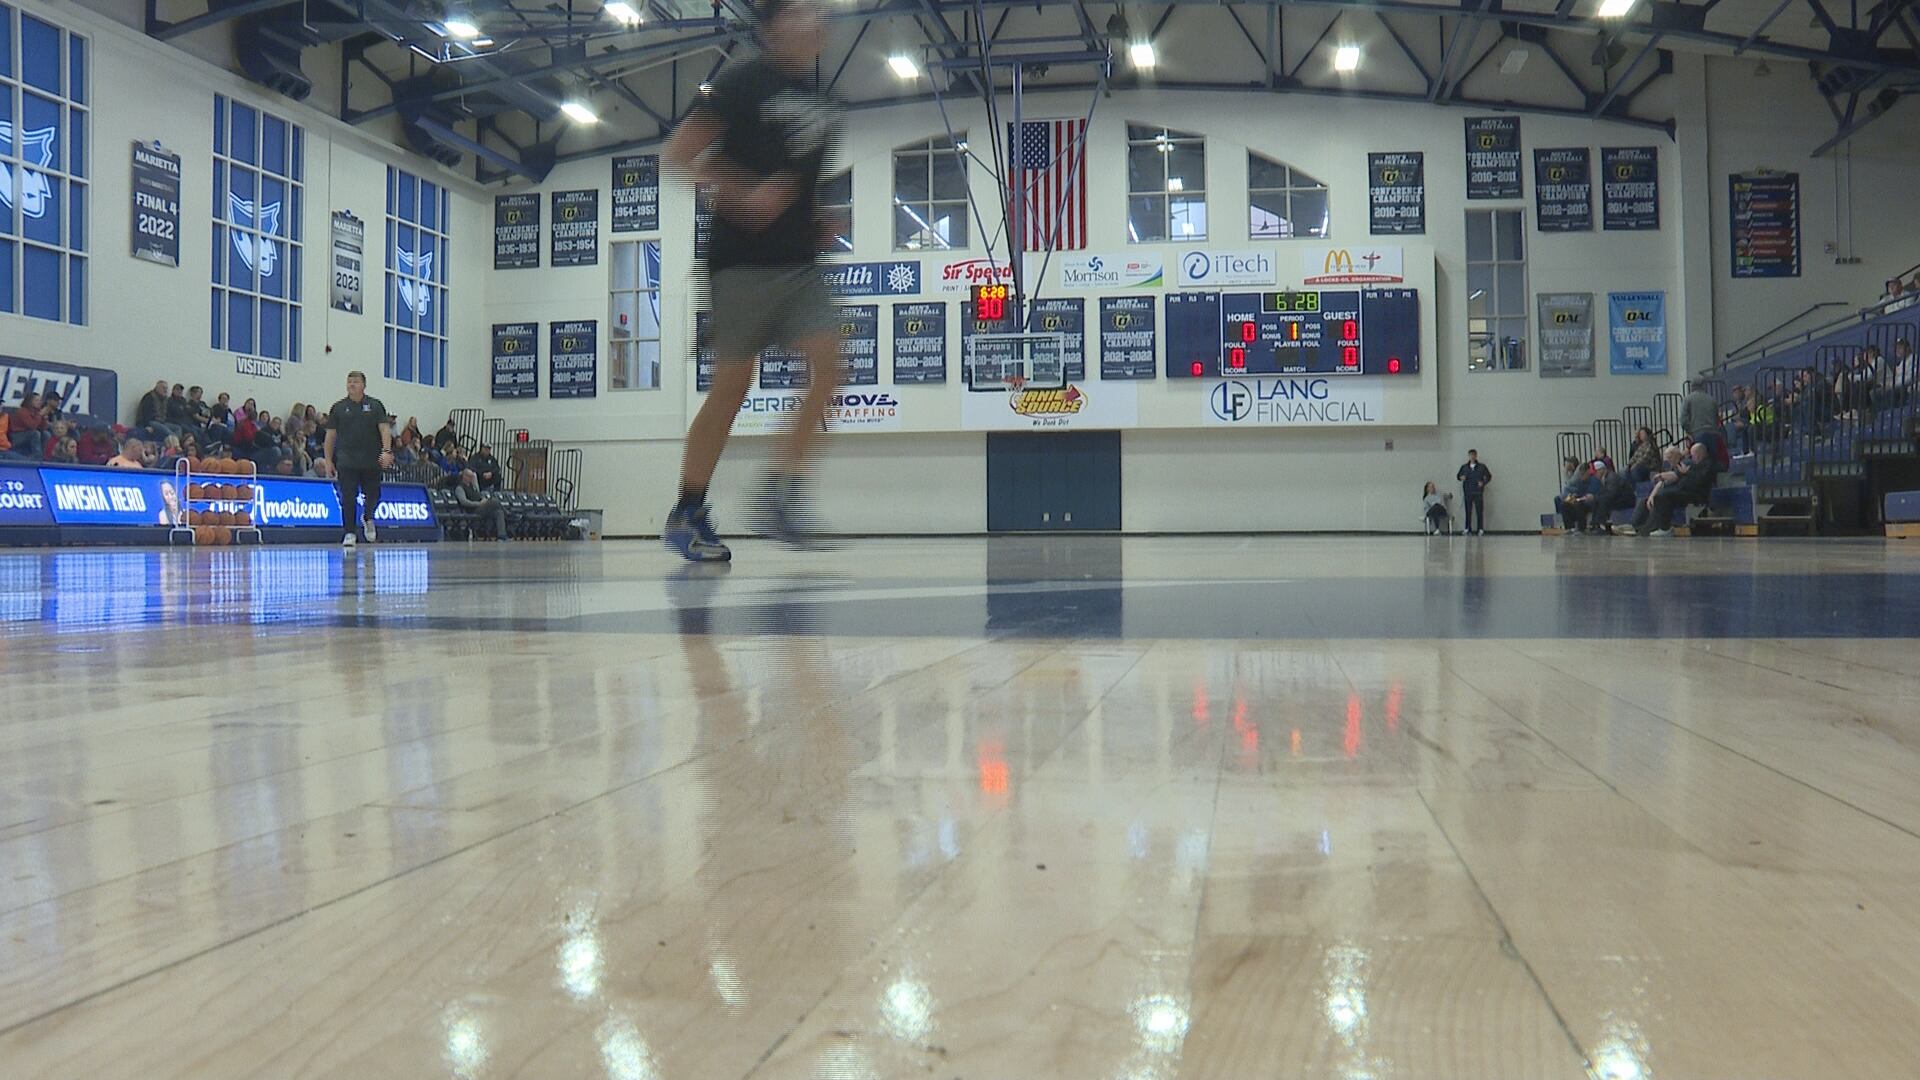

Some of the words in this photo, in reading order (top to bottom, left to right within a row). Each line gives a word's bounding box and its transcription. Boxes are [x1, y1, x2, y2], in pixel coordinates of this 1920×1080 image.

[1467, 151, 1520, 161] TOURNAMENT
[135, 150, 179, 174] MARIETTA
[1471, 159, 1517, 168] CHAMPIONS
[1471, 171, 1517, 183] 2010-2011
[613, 186, 658, 197] CONFERENCE
[1370, 186, 1423, 195] CONFERENCE
[136, 192, 168, 214] FINAL
[169, 201, 177, 216] 4
[615, 194, 657, 204] CHAMPIONS
[1373, 194, 1421, 203] CHAMPIONS
[1374, 206, 1420, 218] 2010-2011
[138, 213, 175, 240] 2022
[496, 224, 539, 235] CONFERENCE
[552, 221, 597, 231] CONFERENCE
[498, 232, 538, 241] CHAMPIONS
[555, 229, 596, 238] CHAMPIONS
[554, 239, 595, 251] 1953-1954
[1215, 253, 1269, 273] iTech
[821, 265, 873, 285] ealth
[942, 264, 963, 280] Sir
[965, 261, 1013, 283] Speed
[1064, 269, 1119, 283] Morrison
[336, 271, 360, 292] 2023
[980, 286, 1005, 300] 6:28
[977, 299, 1004, 320] 30
[1227, 313, 1256, 322] HOME
[1323, 311, 1358, 320] GUEST
[1242, 322, 1256, 342] 0
[1344, 320, 1357, 340] 0
[1612, 327, 1664, 335] CONFERENCE
[895, 337, 943, 346] CONFERENCE
[1102, 331, 1154, 341] TOURNAMENT
[1615, 334, 1662, 343] CHAMPIONS
[898, 344, 942, 353] CHAMPIONS
[966, 343, 1011, 351] CAMPIONS
[1105, 339, 1152, 348] CHAMPIONS
[495, 355, 536, 364] CONFERENCE
[553, 353, 595, 363] CONFERENCE
[964, 354, 1012, 366] 220-2021
[1033, 352, 1082, 363] 2021-022
[1103, 350, 1153, 362] 2021-2022
[1231, 348, 1244, 368] 0
[1344, 347, 1357, 366] 0
[237, 357, 280, 378] VISITORS
[497, 361, 534, 370] CHAMPIONS
[555, 360, 593, 369] CHAMPIONS
[895, 356, 943, 368] 2020-2021
[1257, 379, 1328, 400] LANG
[1015, 400, 1083, 415] SOURCE
[1257, 401, 1375, 422] FINANCIAL
[7, 481, 24, 492] TO
[54, 484, 110, 511] AMISHA
[108, 486, 147, 512] HERD
